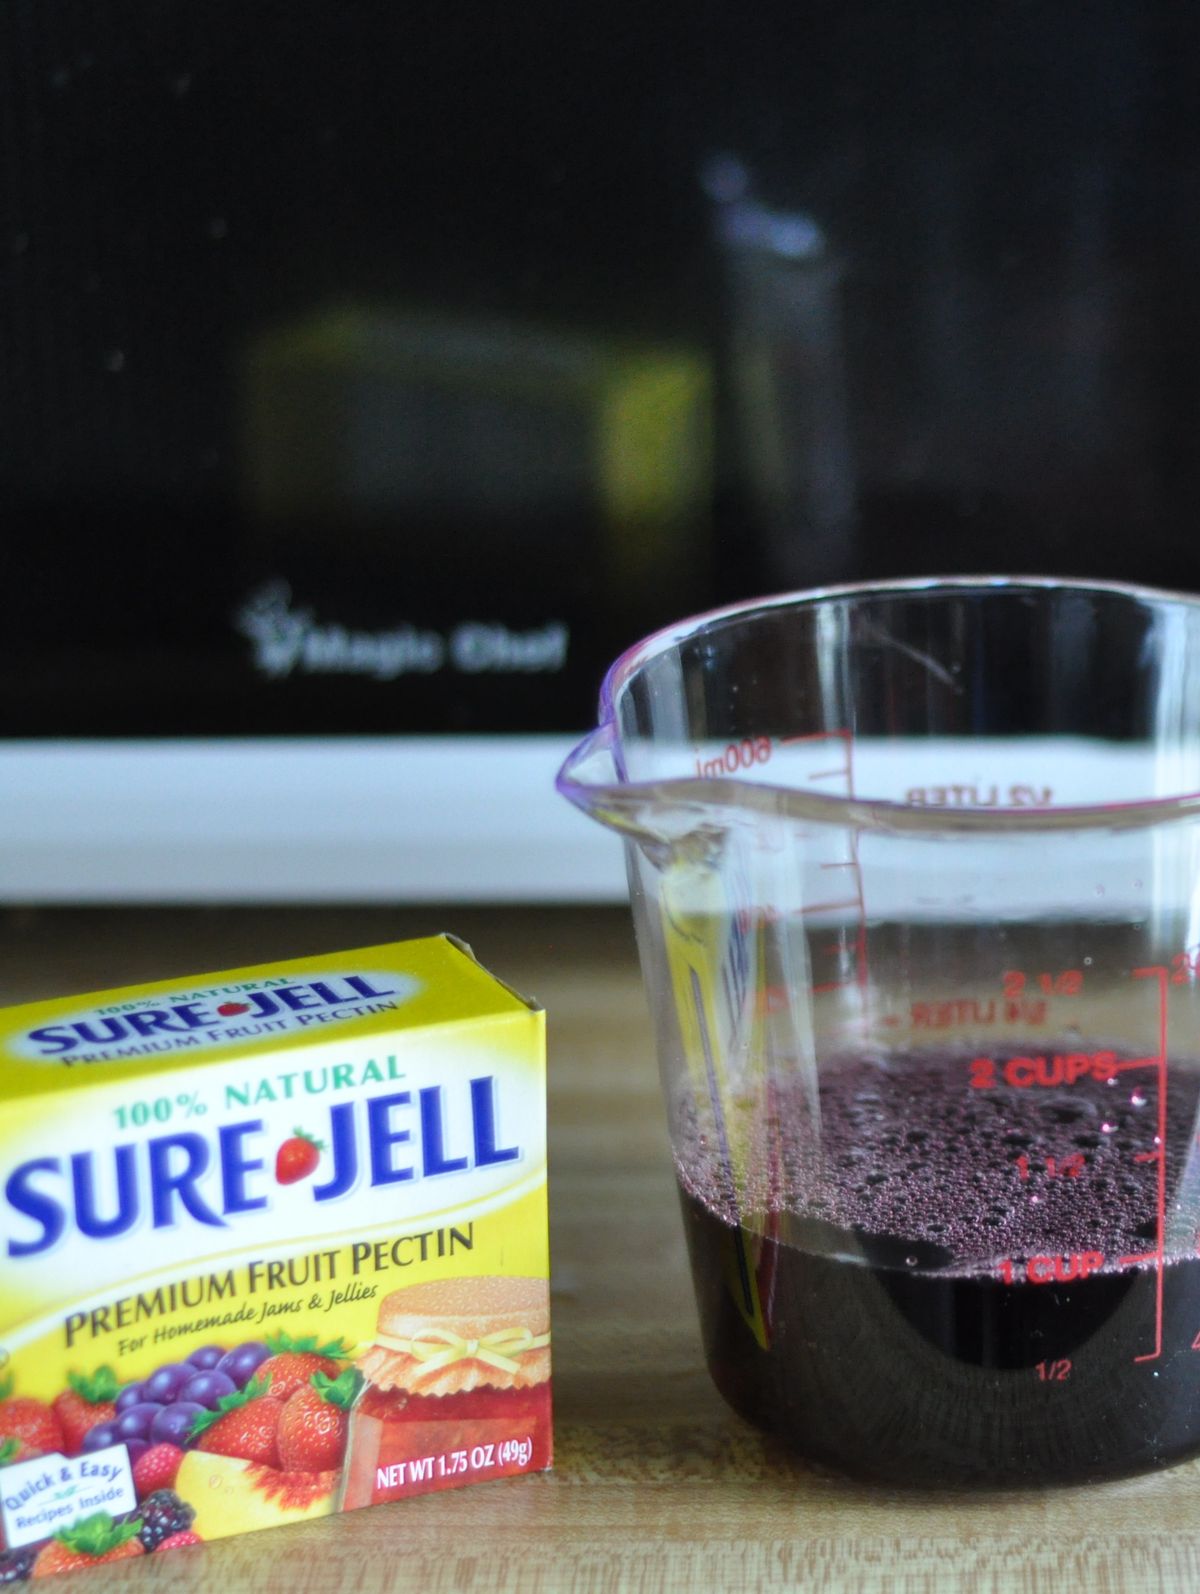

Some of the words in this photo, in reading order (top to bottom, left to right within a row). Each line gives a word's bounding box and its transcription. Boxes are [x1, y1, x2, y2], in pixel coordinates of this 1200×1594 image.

[28, 1003, 217, 1055] SURE
[249, 976, 394, 1019] JELL
[94, 999, 161, 1016] 100%
[170, 978, 296, 1003] NATURAL
[62, 1034, 200, 1068] PREMIUM
[208, 1020, 286, 1043] FRUIT
[300, 1000, 399, 1027] PECTIN
[113, 1091, 207, 1131] 100%
[225, 1055, 406, 1110] NATURAL
[970, 1057, 997, 1089] 2
[1003, 1051, 1118, 1089] CUPS
[4, 1119, 268, 1257] SURE
[312, 1076, 519, 1202] JELL
[63, 1269, 236, 1348] PREMIUM
[248, 1250, 340, 1293] FRUIT
[351, 1222, 474, 1275] PECTIN
[999, 1258, 1013, 1285] 1
[1026, 1250, 1105, 1284] CUP
[118, 1336, 147, 1356] For
[153, 1309, 256, 1343] Homemade
[257, 1299, 302, 1324] Jams
[308, 1294, 322, 1310] &
[325, 1282, 379, 1313] Jellies
[1036, 1359, 1072, 1382] 1/2
[5, 1473, 54, 1511] Quick
[60, 1467, 72, 1482] &
[80, 1461, 122, 1483] Easy
[377, 1463, 406, 1489] NET
[410, 1457, 435, 1482] WT
[438, 1450, 467, 1476] 1.75
[471, 1444, 495, 1469] OZ
[498, 1436, 532, 1467] (49g)
[16, 1504, 73, 1529] Recipes
